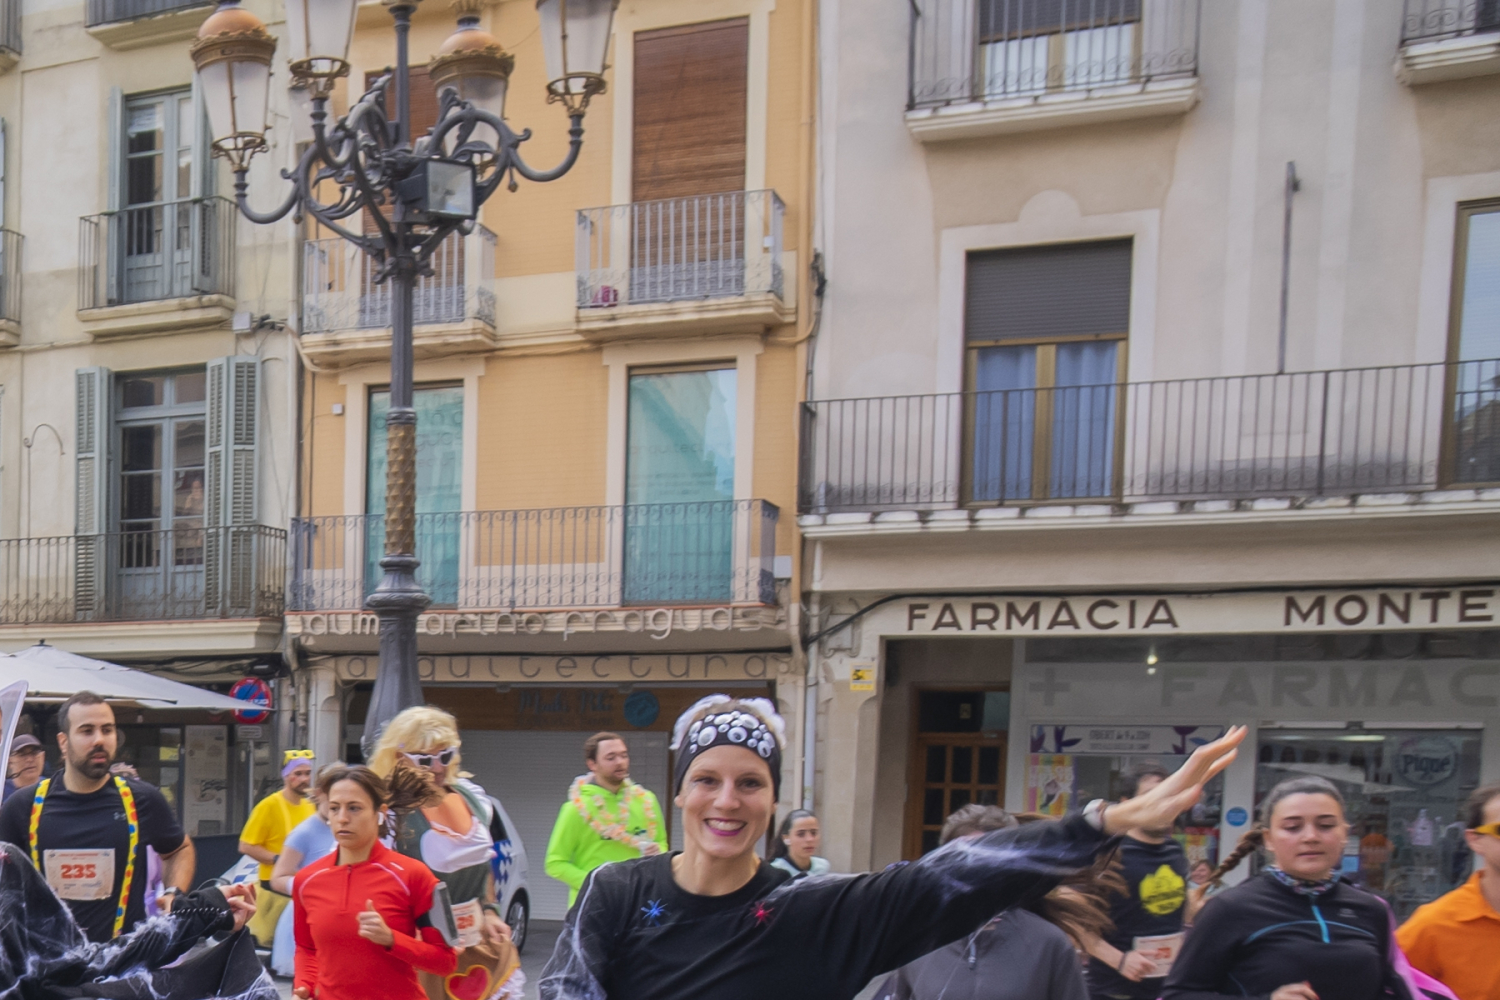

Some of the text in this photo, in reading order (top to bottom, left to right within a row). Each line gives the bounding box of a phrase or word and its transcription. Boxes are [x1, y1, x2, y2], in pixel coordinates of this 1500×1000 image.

[1283, 589, 1495, 627] MONTE
[347, 654, 767, 682] aquitectura
[60, 863, 97, 879] 235
